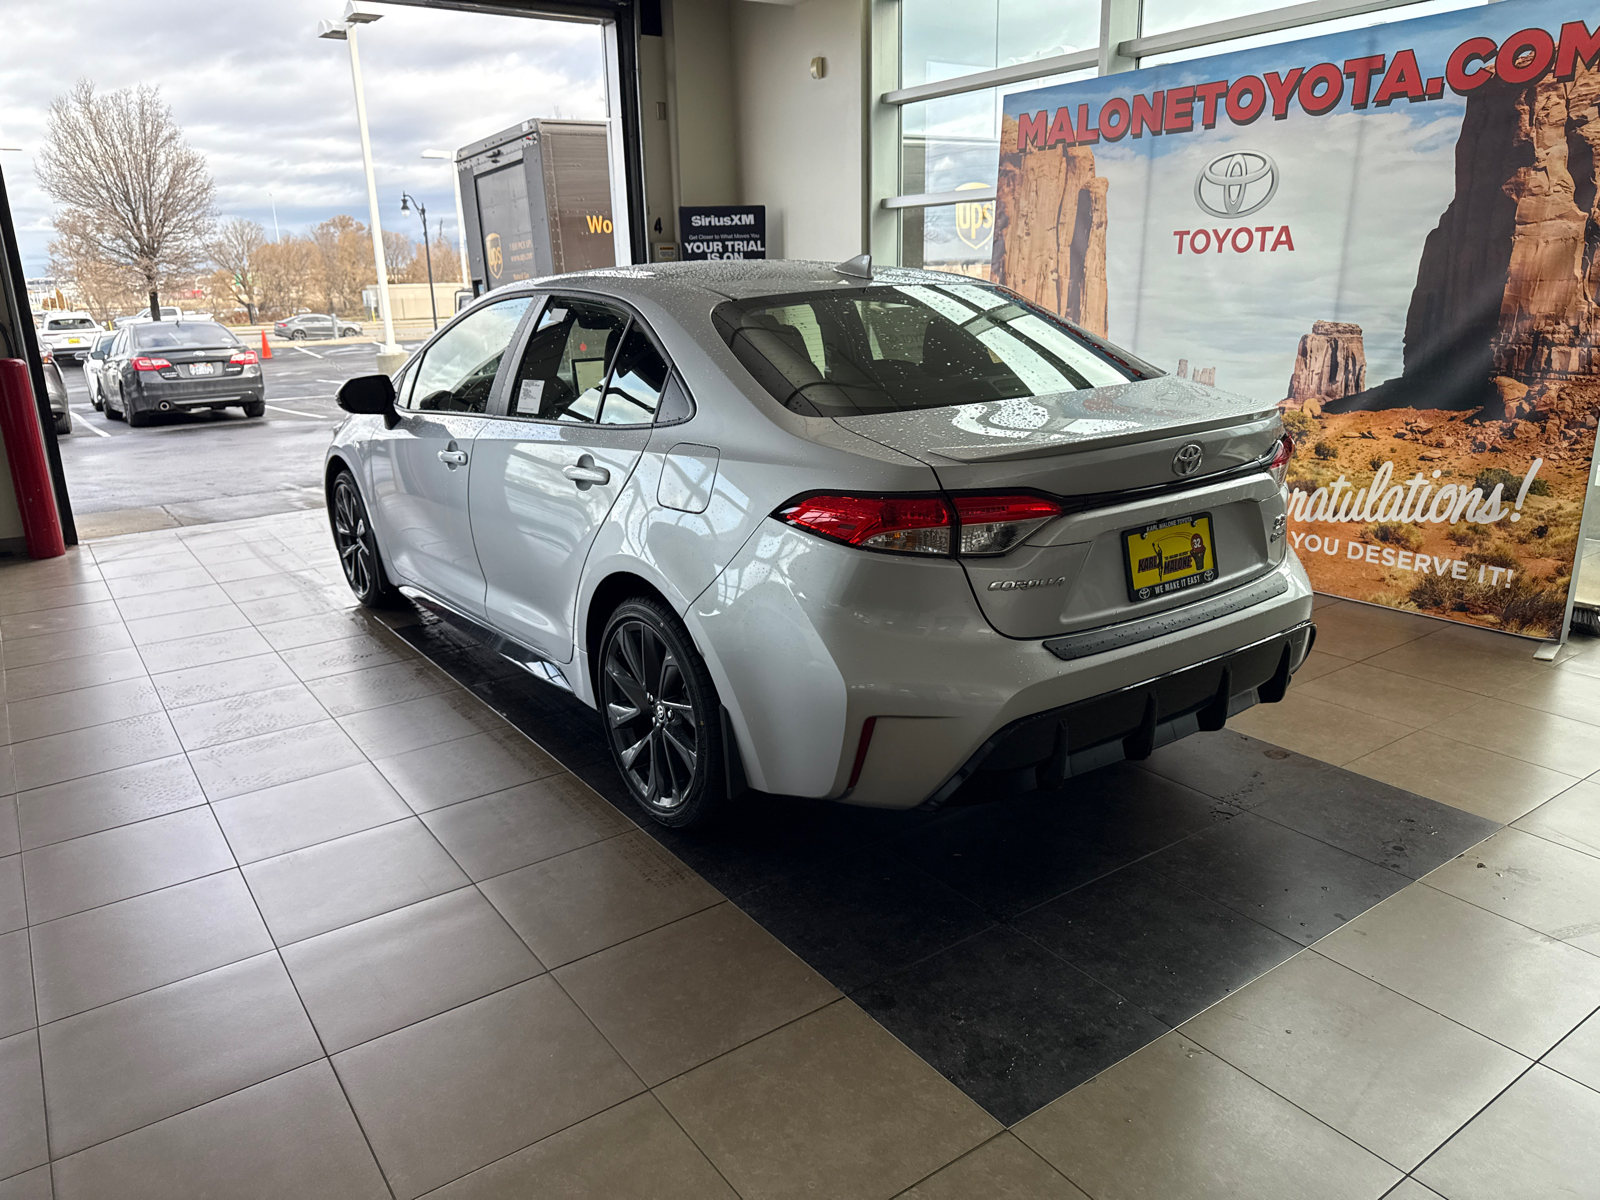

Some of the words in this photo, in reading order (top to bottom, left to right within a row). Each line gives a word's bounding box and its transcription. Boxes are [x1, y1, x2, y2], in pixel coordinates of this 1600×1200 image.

[1017, 20, 1600, 151] MALONETOYOTA.COM
[586, 215, 613, 234] Wo
[654, 217, 662, 234] 4
[691, 214, 755, 227] SiriusXM
[958, 202, 993, 239] ups
[685, 241, 723, 253] YOUR
[725, 240, 765, 252] TRIAL
[1173, 225, 1294, 254] TOYOTA
[488, 246, 502, 272] ups
[723, 252, 744, 260] ON
[1287, 458, 1543, 524] ratulations!
[1193, 538, 1202, 548] 32
[1291, 531, 1339, 556] YOU
[1347, 541, 1468, 581] DESERVE
[1478, 564, 1513, 589] IT!
[987, 576, 1065, 591] COROLLA
[1155, 586, 1164, 594] WE
[1165, 582, 1180, 591] MAKE
[1181, 579, 1186, 587] IT
[1188, 575, 1200, 585] EASY
